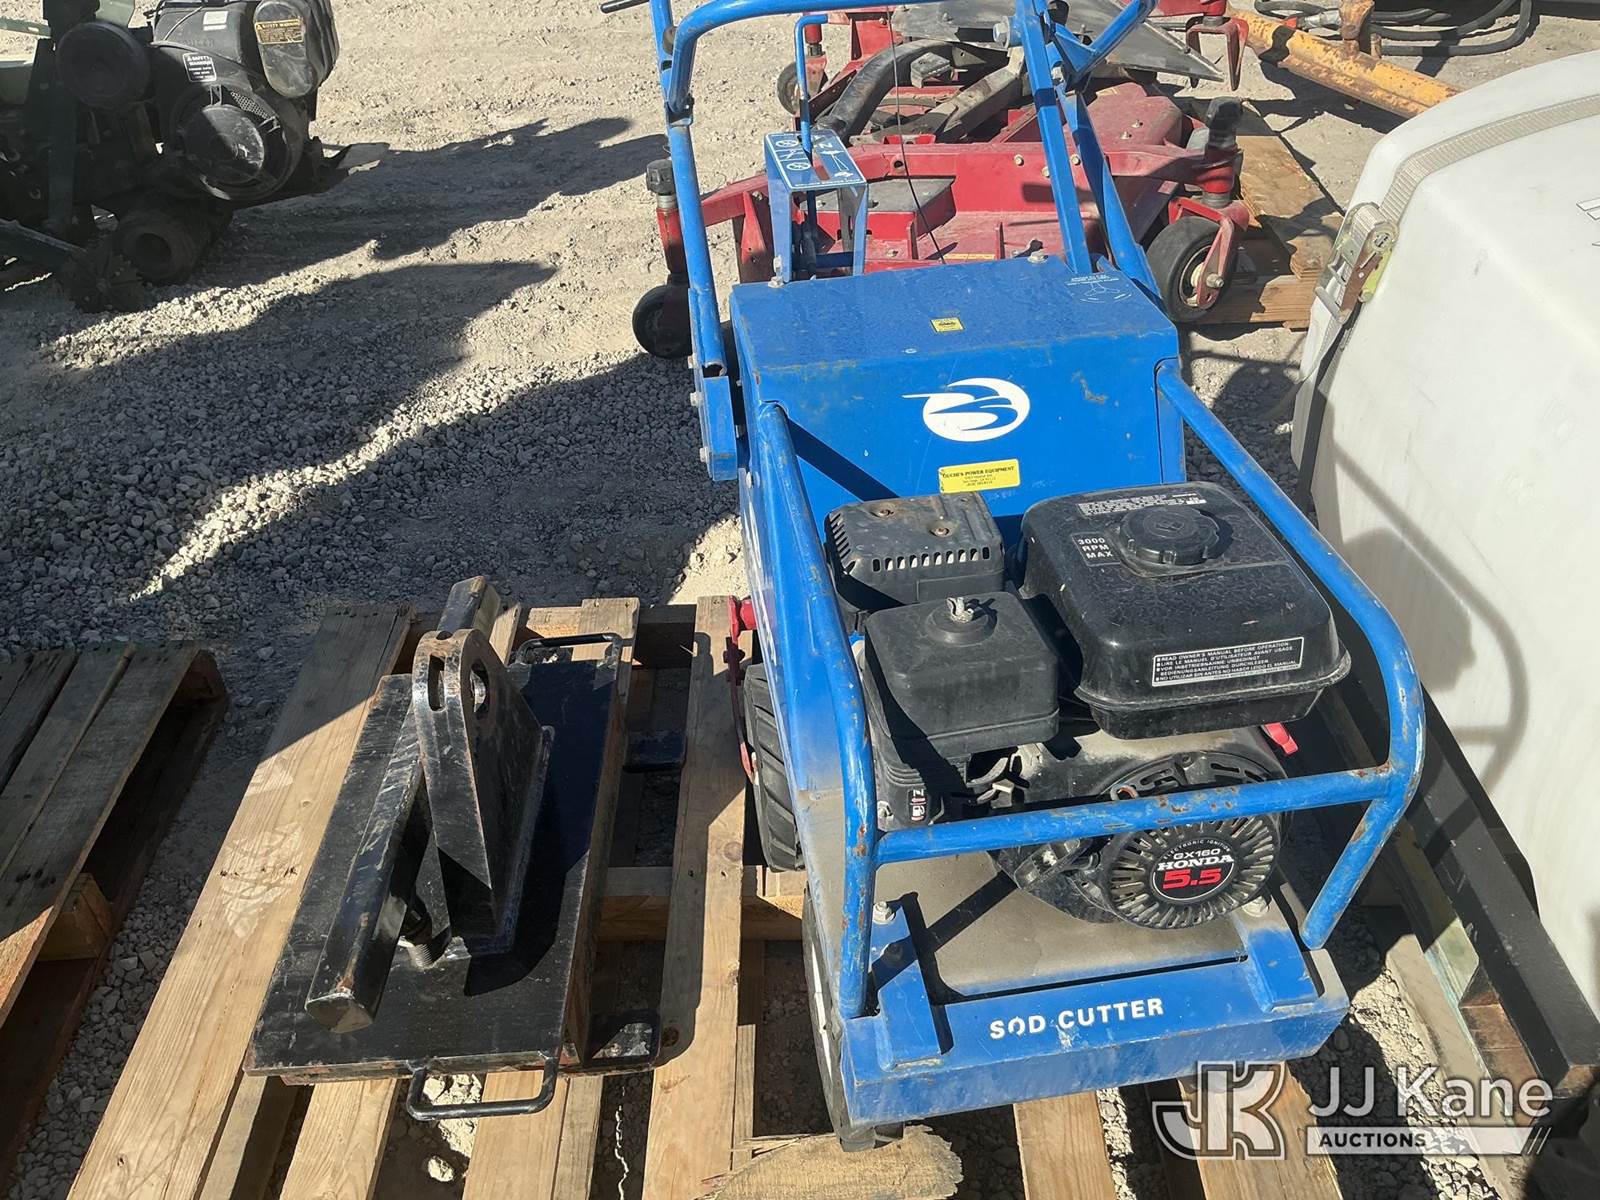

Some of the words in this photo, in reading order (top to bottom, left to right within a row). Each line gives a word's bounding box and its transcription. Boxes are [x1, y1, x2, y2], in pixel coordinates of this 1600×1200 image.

[965, 469, 984, 477] POWER
[984, 466, 1015, 474] EQUIPMENT
[1078, 537, 1106, 545] 3000
[1081, 544, 1110, 552] RPM
[1085, 551, 1114, 559] MAX
[1256, 642, 1289, 650] OPERATION
[1226, 656, 1260, 664] UNBEDINGT
[1173, 848, 1221, 860] GX160
[1157, 854, 1235, 871] HONDA
[1162, 868, 1222, 890] 5.5
[989, 1015, 1046, 1040] SOD
[1057, 998, 1164, 1030] CUTTER
